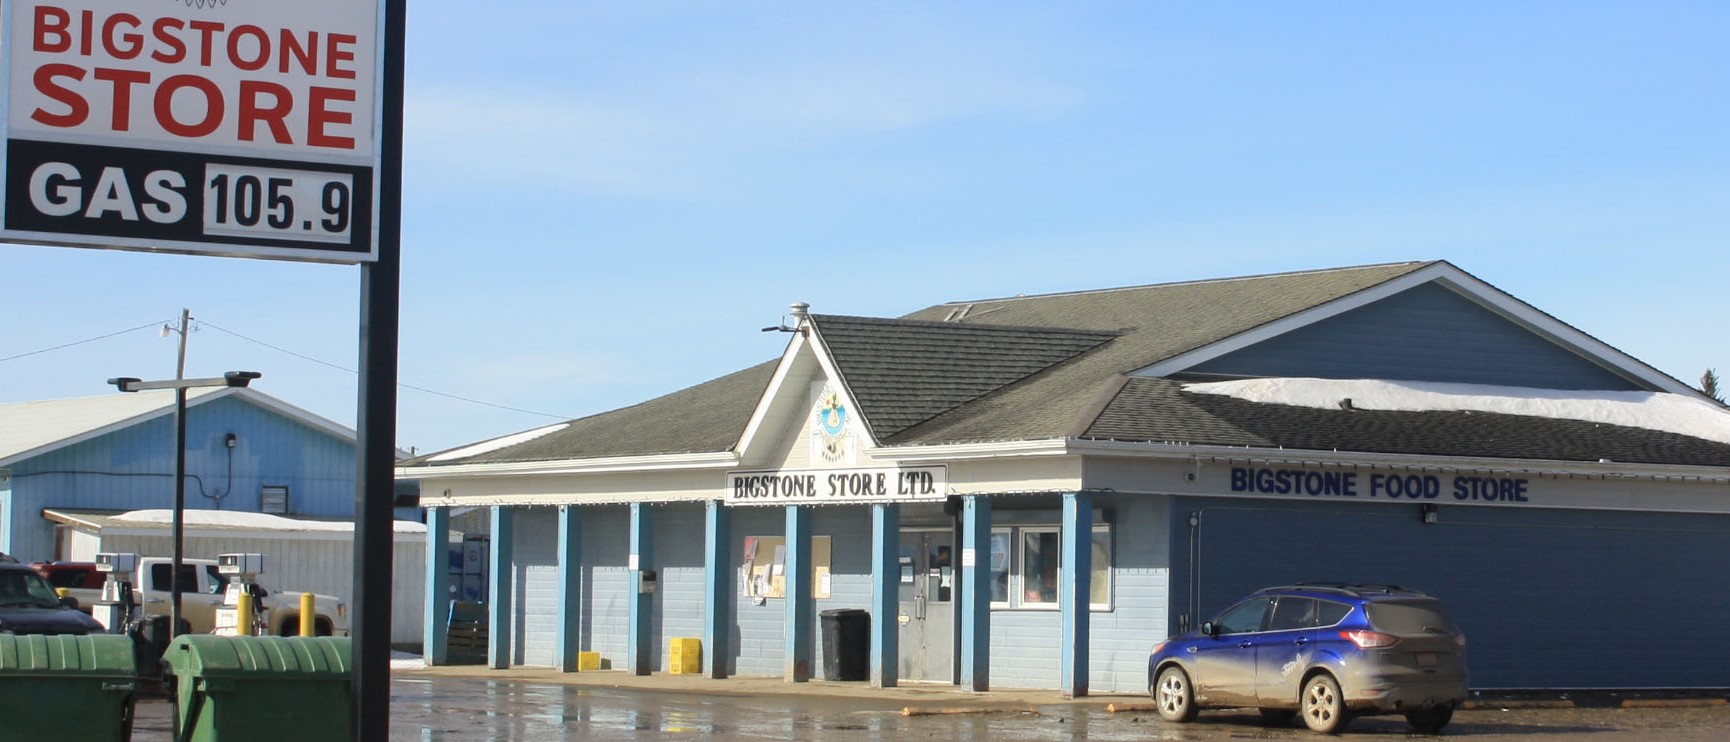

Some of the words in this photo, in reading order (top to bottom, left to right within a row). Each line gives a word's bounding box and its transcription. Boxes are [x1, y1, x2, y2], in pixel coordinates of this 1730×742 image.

[33, 5, 357, 80] BIGSTONE
[30, 63, 356, 150] STORE
[29, 161, 188, 224] GAS
[210, 174, 350, 233] 105.9
[733, 474, 817, 499] BIGSTONE
[828, 471, 887, 496] STORE
[897, 470, 936, 496] LTD.
[1230, 467, 1357, 497] BIGSTONE
[1370, 473, 1440, 500] FOOD
[1453, 477, 1529, 502] STORE
